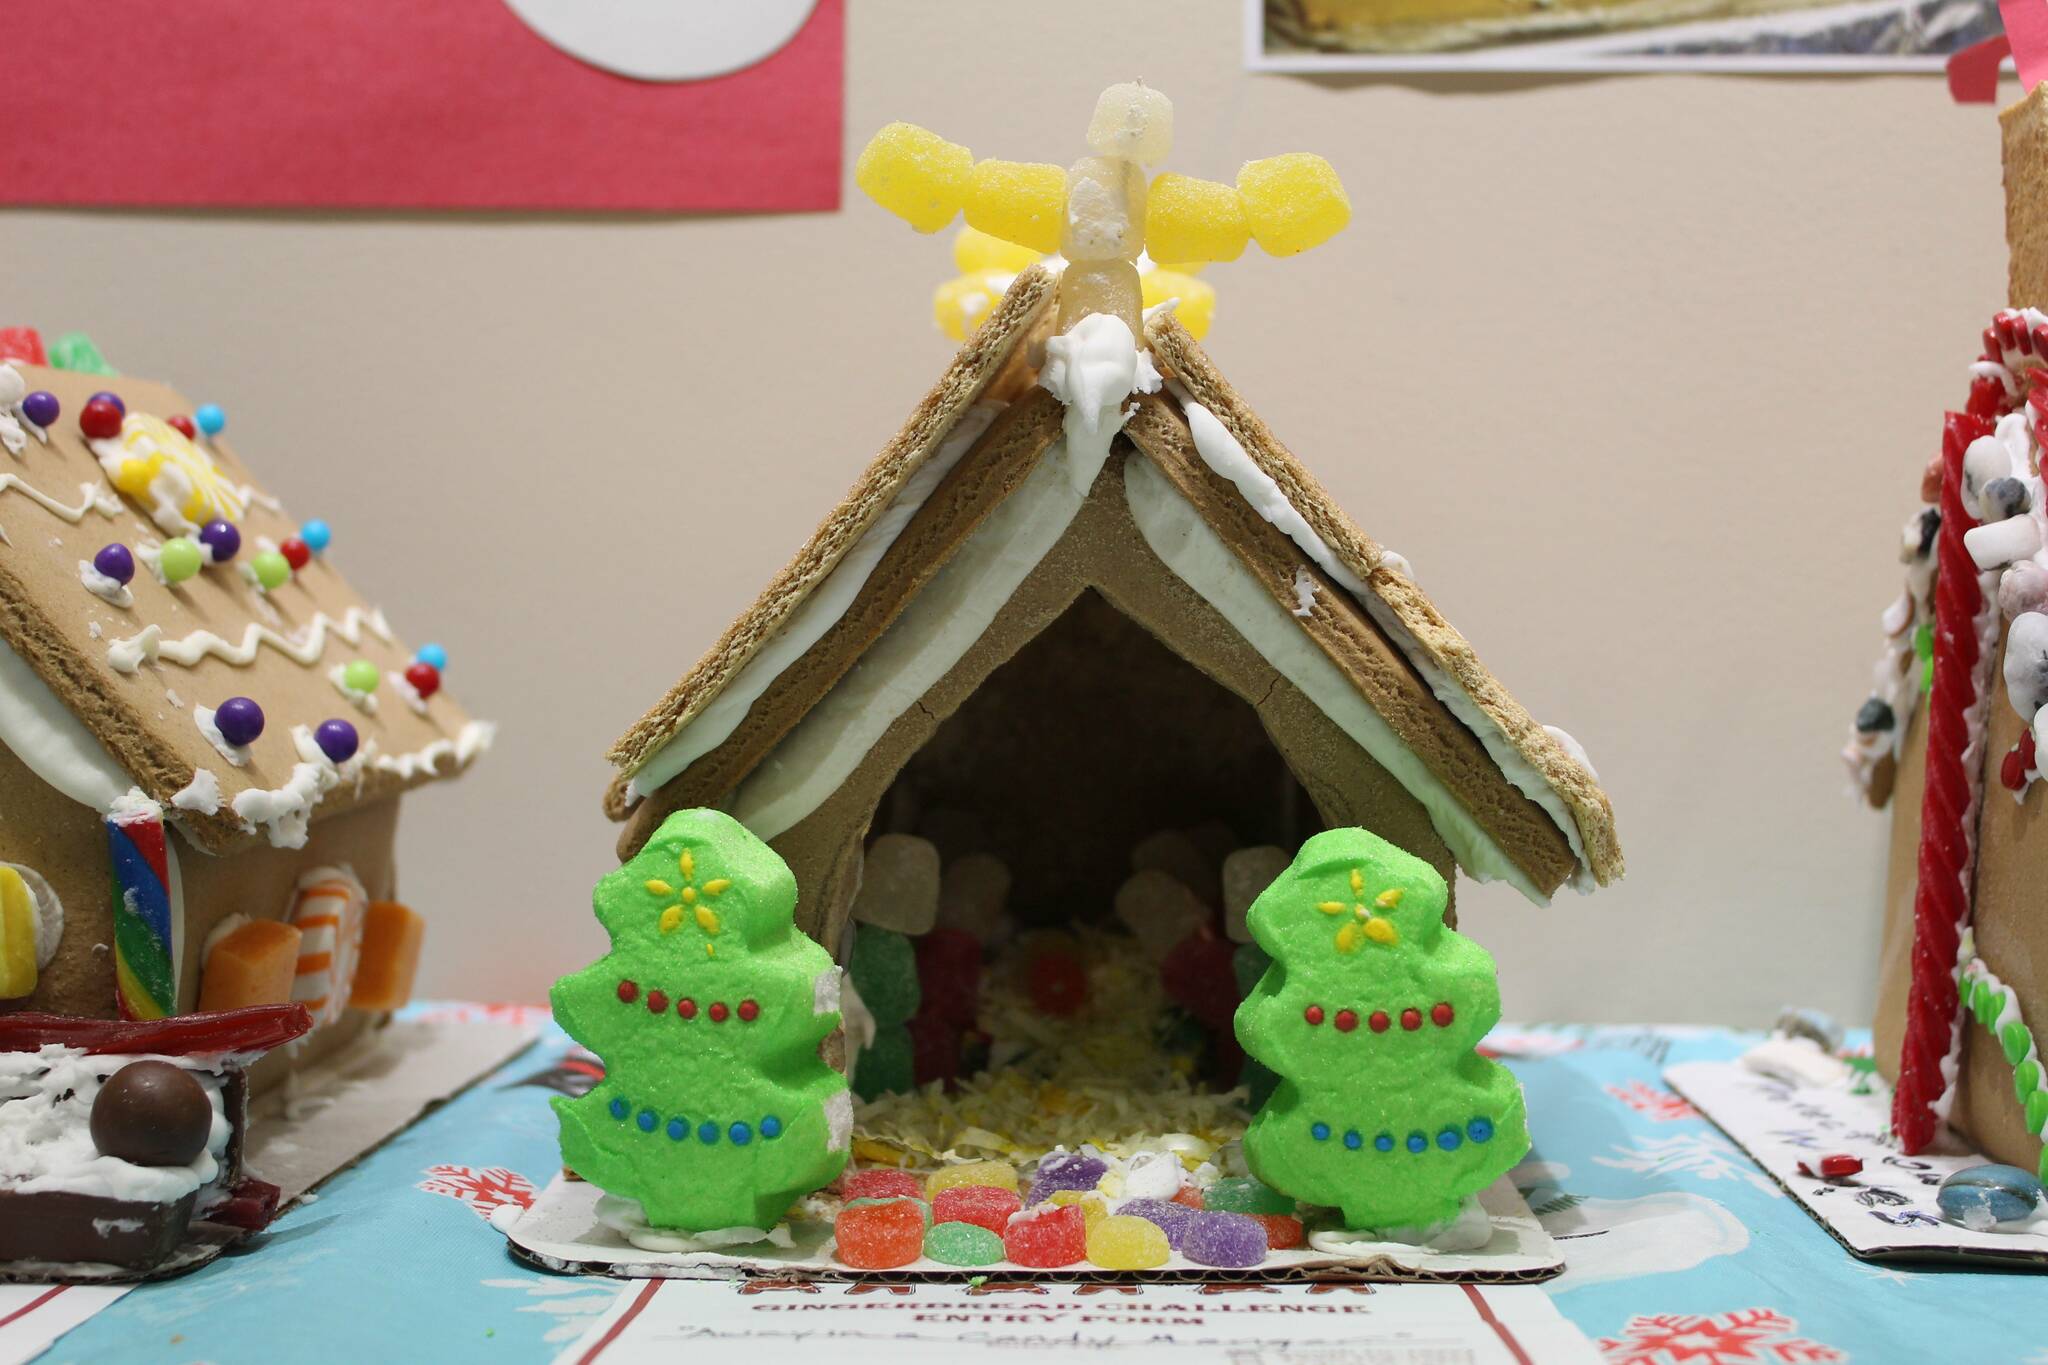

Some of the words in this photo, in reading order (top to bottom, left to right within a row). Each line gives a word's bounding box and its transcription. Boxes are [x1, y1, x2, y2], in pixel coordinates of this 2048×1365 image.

[1096, 1302, 1371, 1314] CHALLENGE
[914, 1313, 1069, 1323] ENTRY
[1081, 1315, 1205, 1326] FORM
